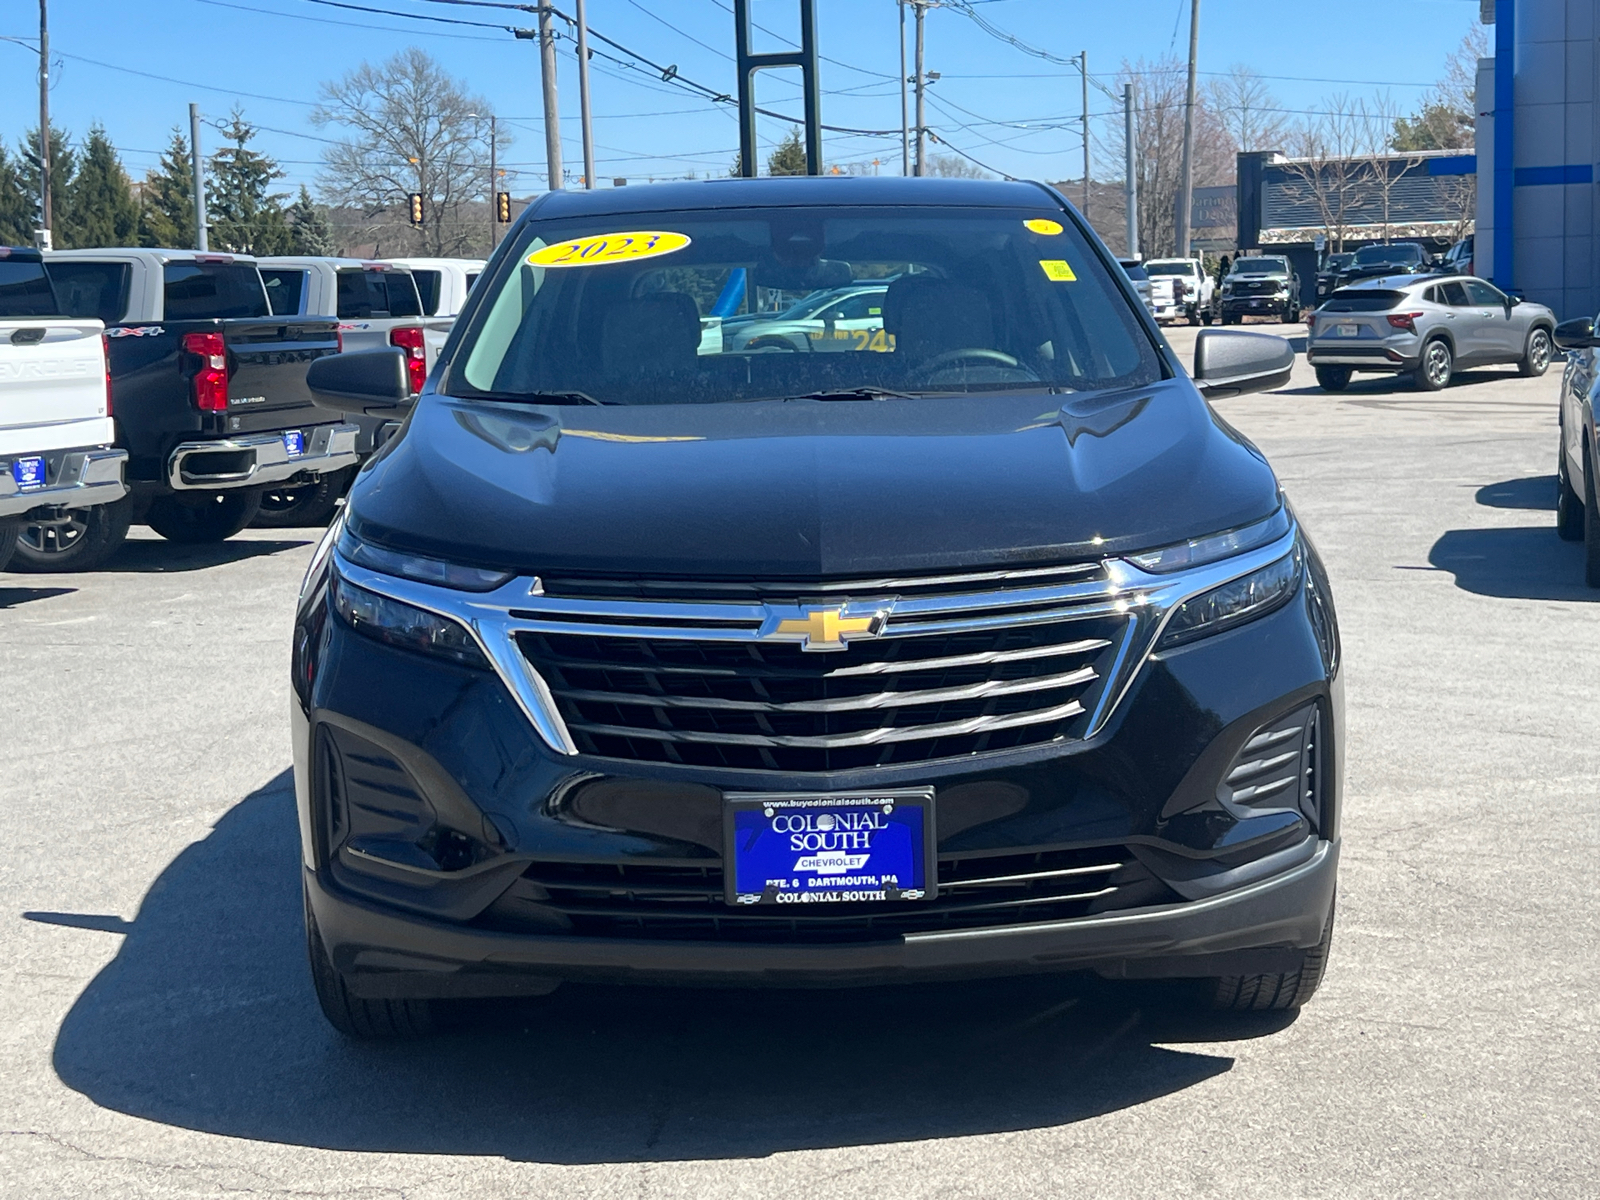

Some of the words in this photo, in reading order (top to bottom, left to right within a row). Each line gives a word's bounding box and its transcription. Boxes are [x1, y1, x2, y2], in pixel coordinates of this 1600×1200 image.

[551, 235, 661, 263] 2023
[763, 797, 894, 808] www.buycolonialsouth.com
[772, 811, 888, 833] COLONIAL
[790, 831, 871, 851] SOUTH
[801, 857, 862, 868] CHEVROLET
[792, 878, 799, 887] 6
[808, 876, 879, 887] DARTMOUTH,
[776, 891, 841, 903] COLONIAL
[842, 890, 886, 901] SOUTH
